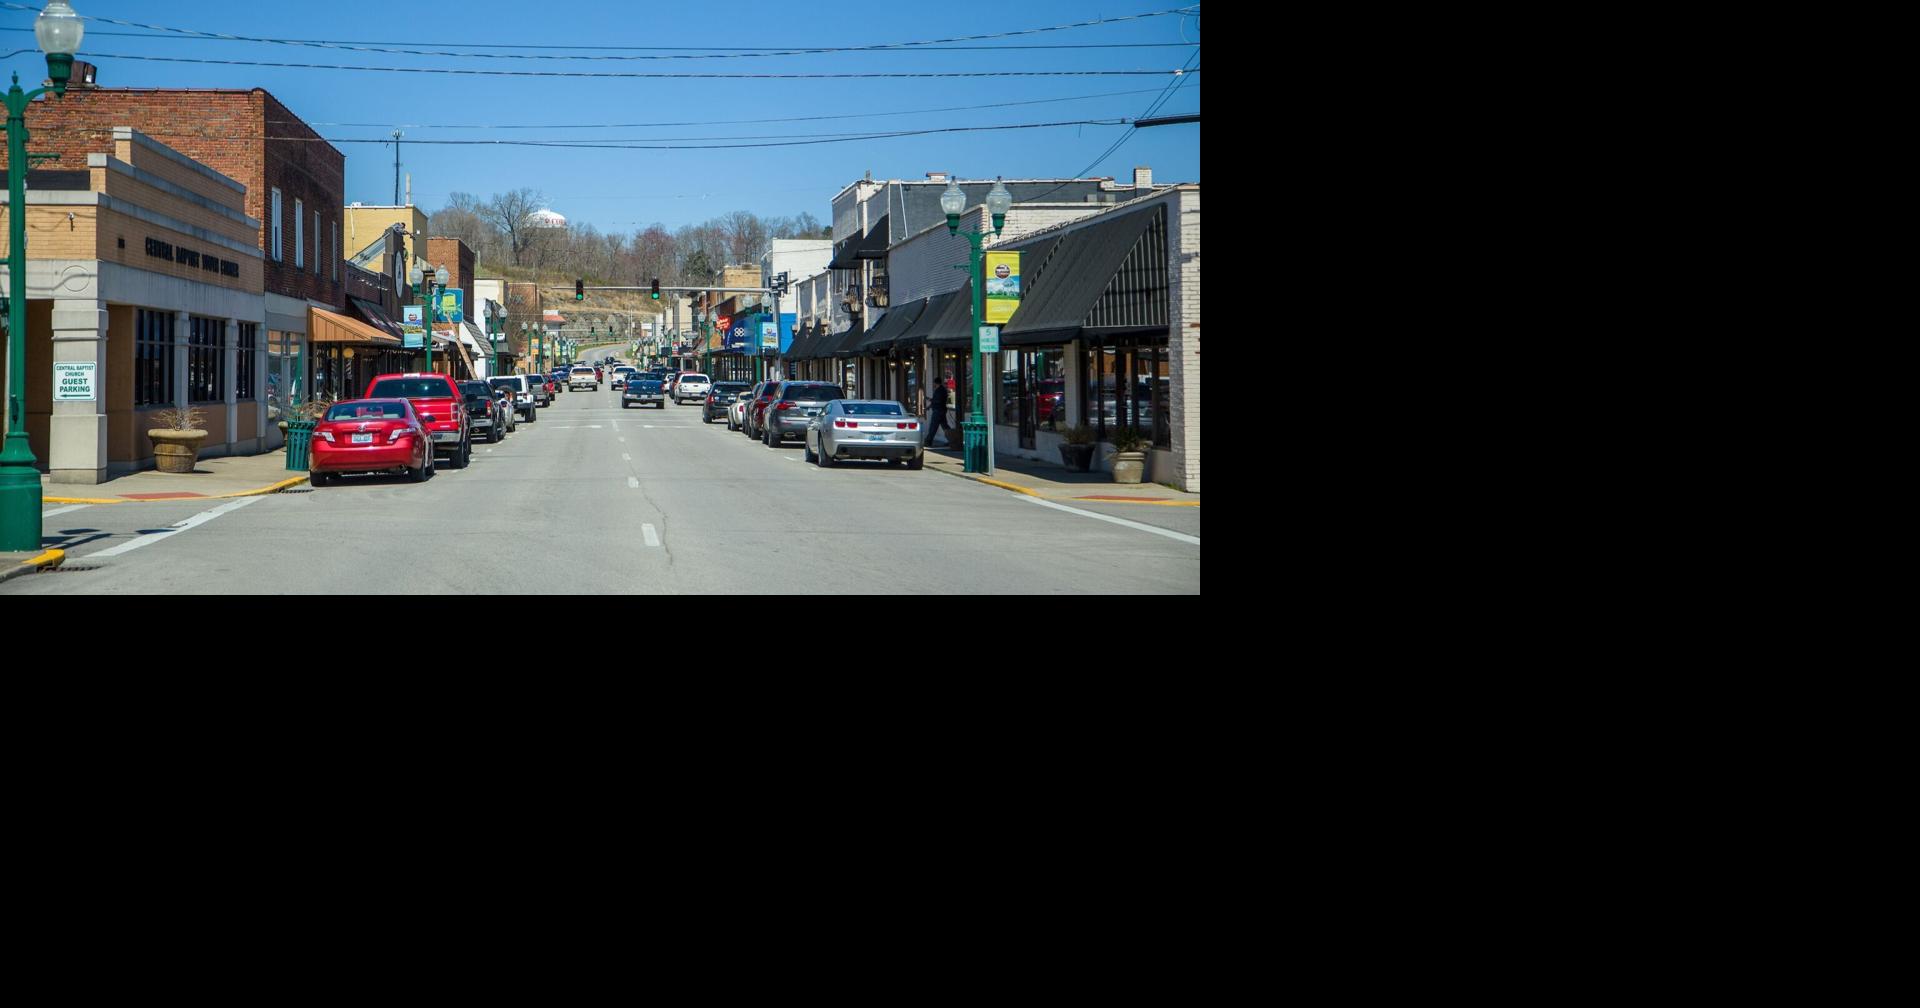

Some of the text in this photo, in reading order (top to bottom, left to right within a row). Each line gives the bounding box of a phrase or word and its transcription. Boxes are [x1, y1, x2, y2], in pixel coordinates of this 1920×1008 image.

[145, 236, 174, 261] CENTRAL
[176, 245, 200, 268] BAPTIST
[985, 328, 992, 336] 5
